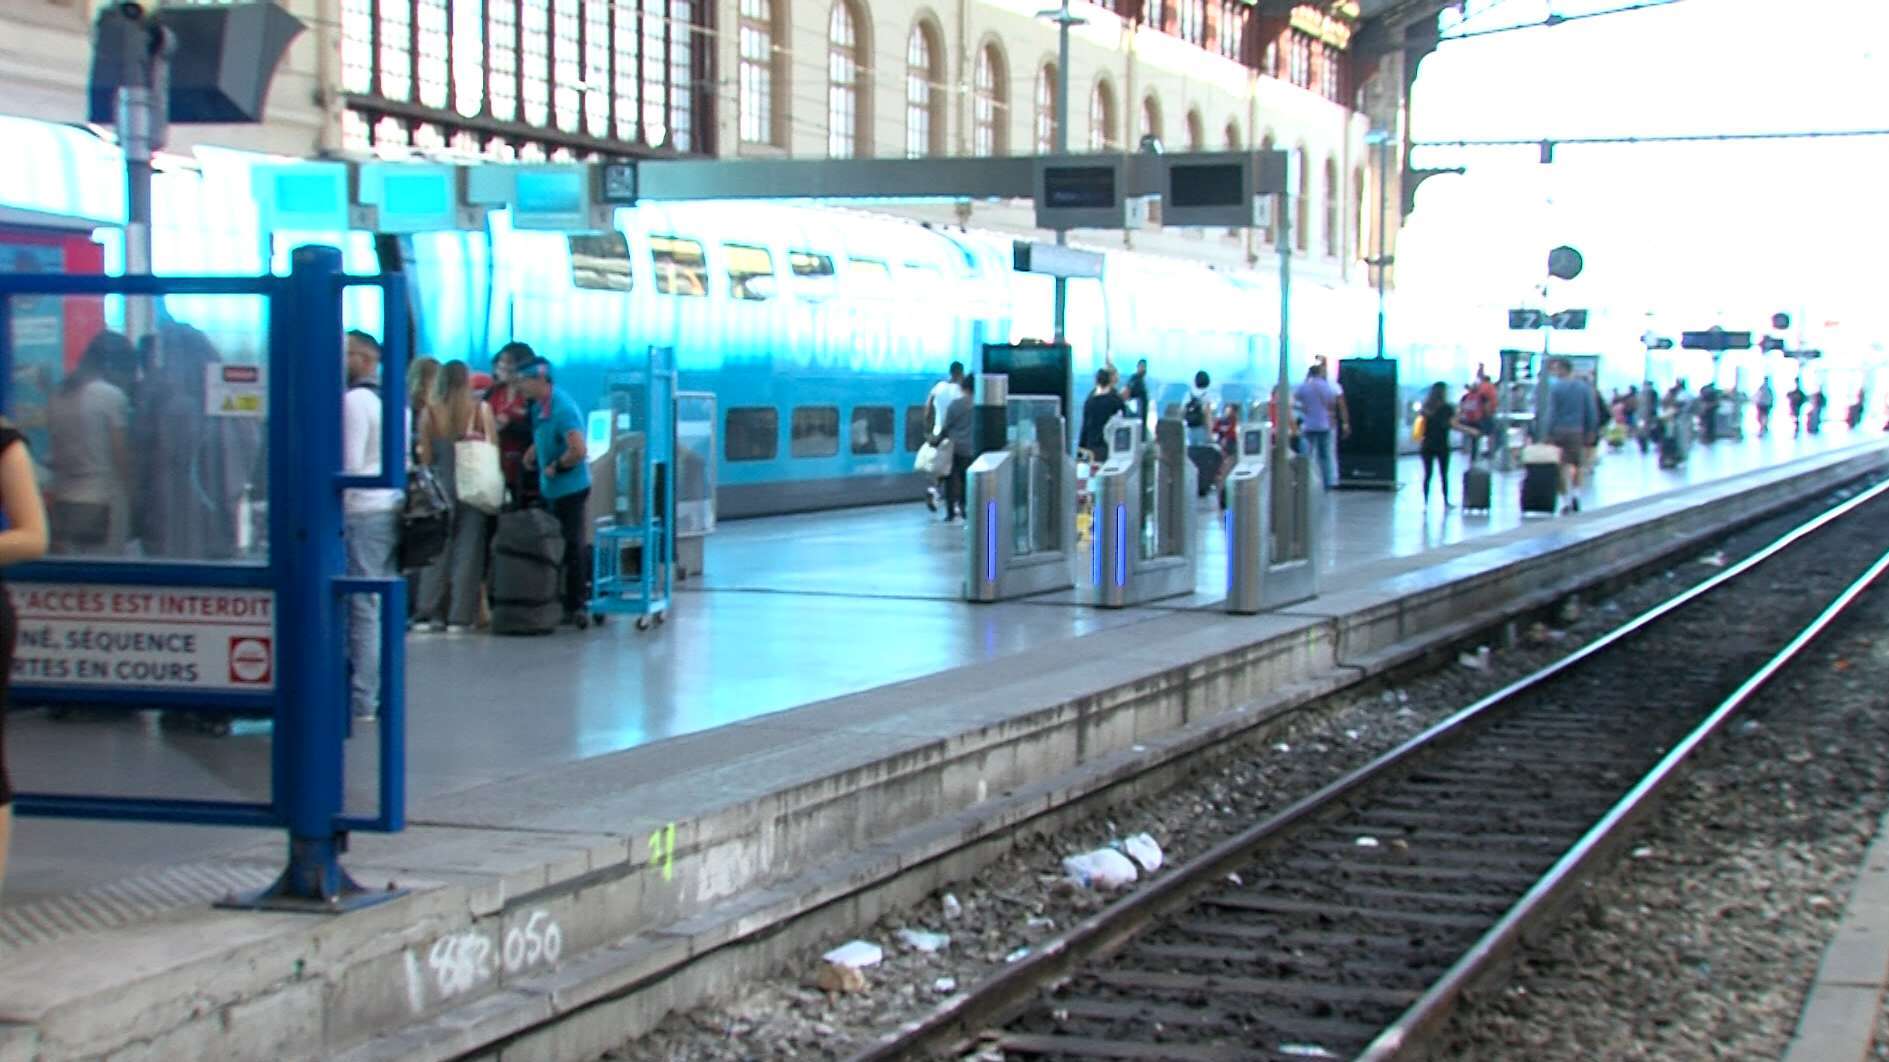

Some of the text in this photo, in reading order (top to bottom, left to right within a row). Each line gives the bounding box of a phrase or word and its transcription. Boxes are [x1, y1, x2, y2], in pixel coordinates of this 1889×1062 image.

[12, 588, 269, 616] 'ACCÈS EST INTERDIT
[67, 627, 197, 653] SÉQUENCE
[11, 658, 198, 682] RTES EN COURS
